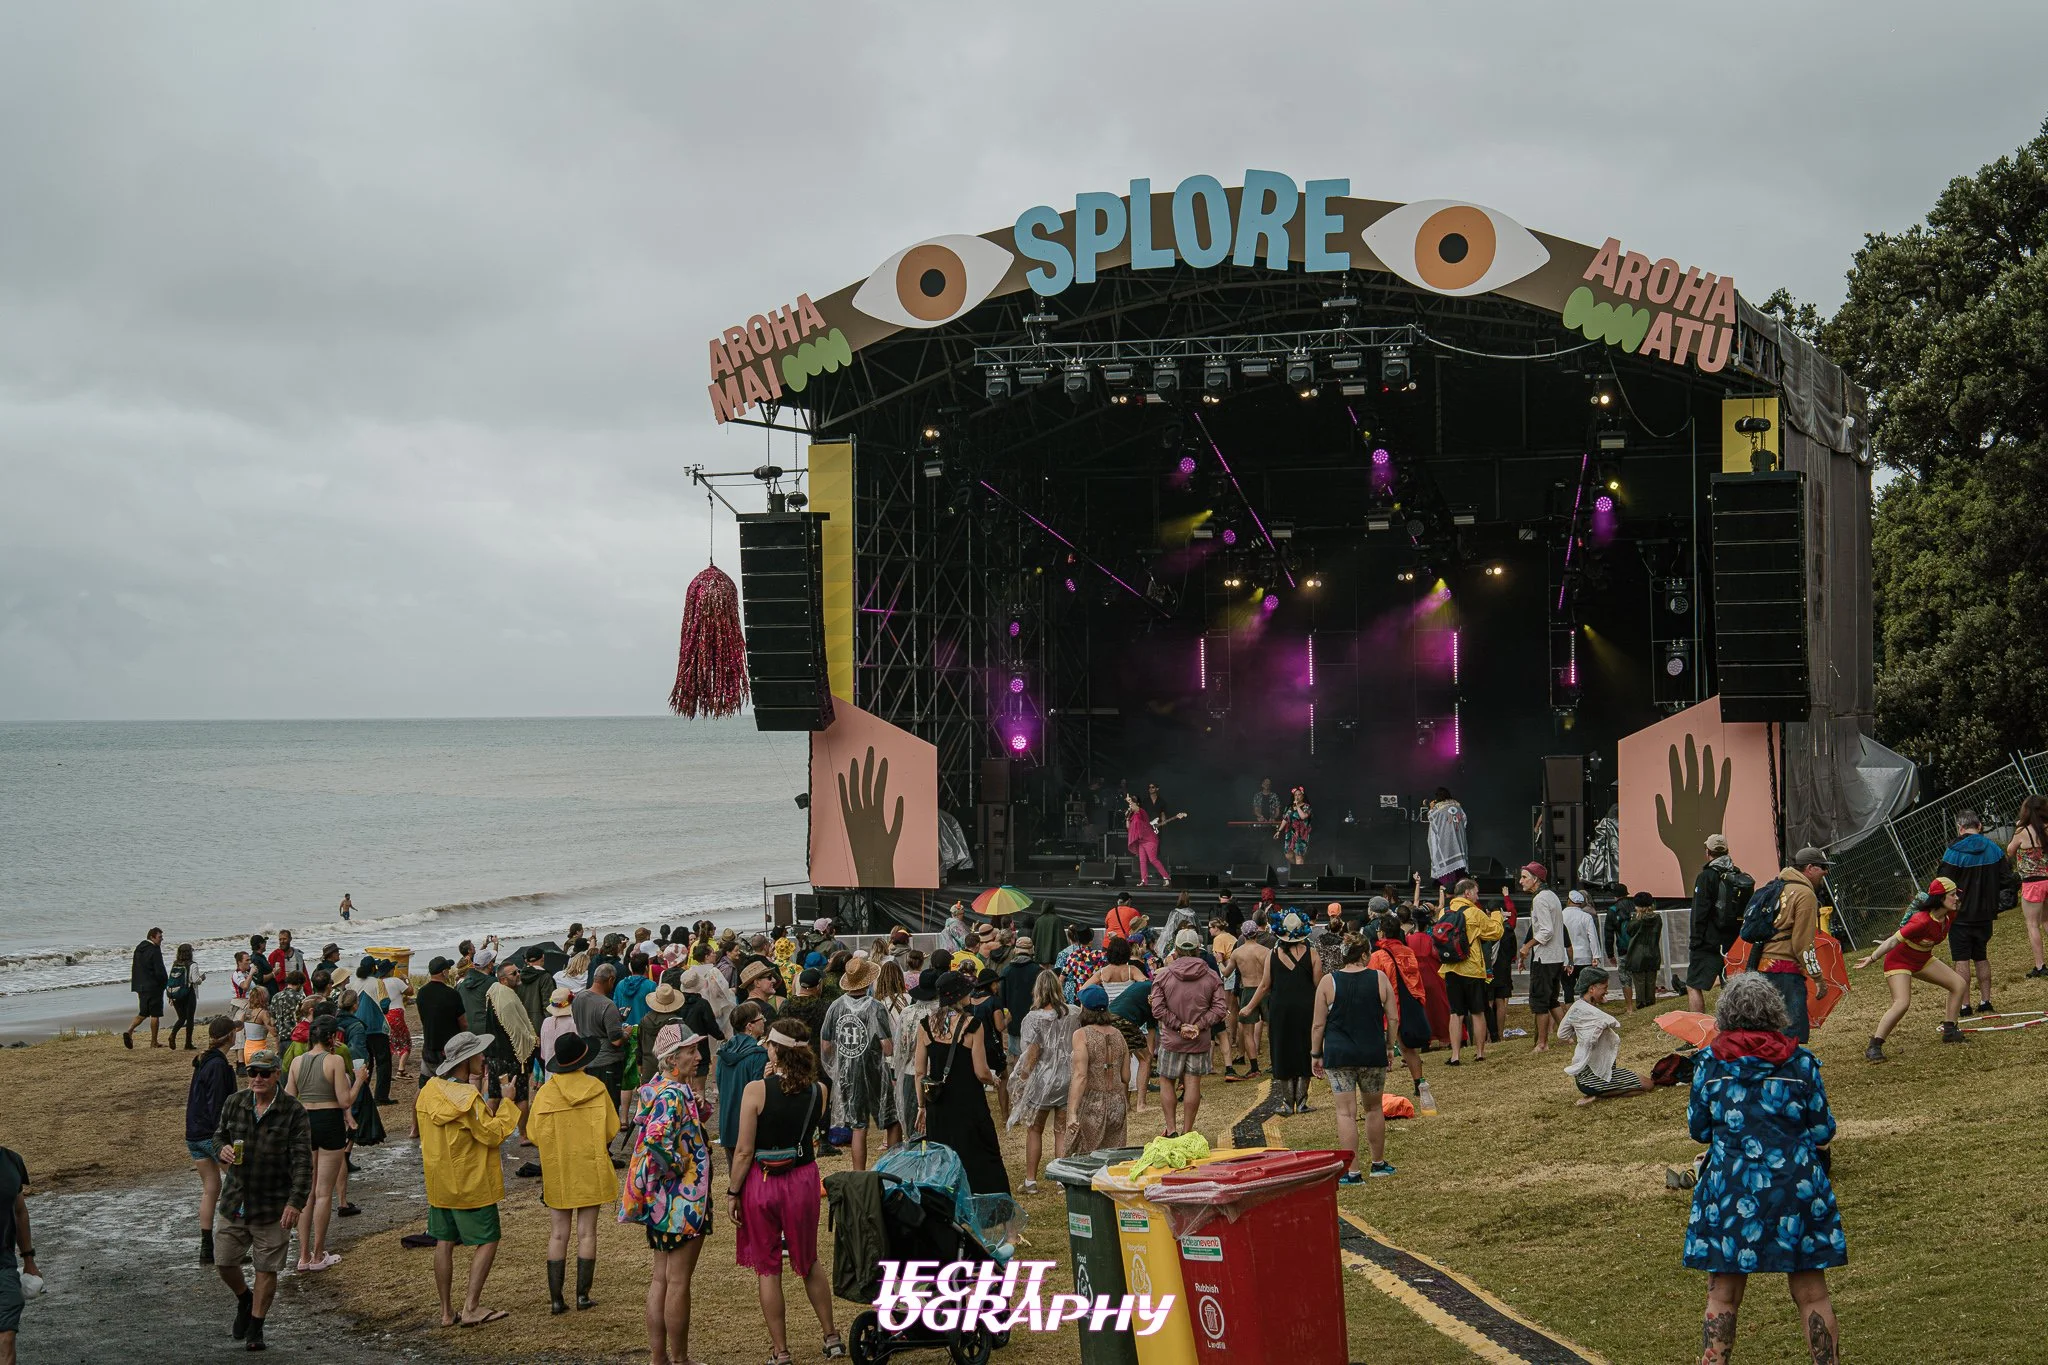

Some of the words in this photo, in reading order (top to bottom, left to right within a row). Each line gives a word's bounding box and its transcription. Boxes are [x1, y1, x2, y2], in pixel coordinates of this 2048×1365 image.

[1014, 169, 1350, 297] SPLORE
[1583, 237, 1736, 324] AROHA
[709, 293, 827, 381] AROHA
[1639, 311, 1734, 373] ATU
[708, 357, 782, 425] MAI
[1076, 1253, 1087, 1264] Food
[1194, 1283, 1219, 1294] Rubbish
